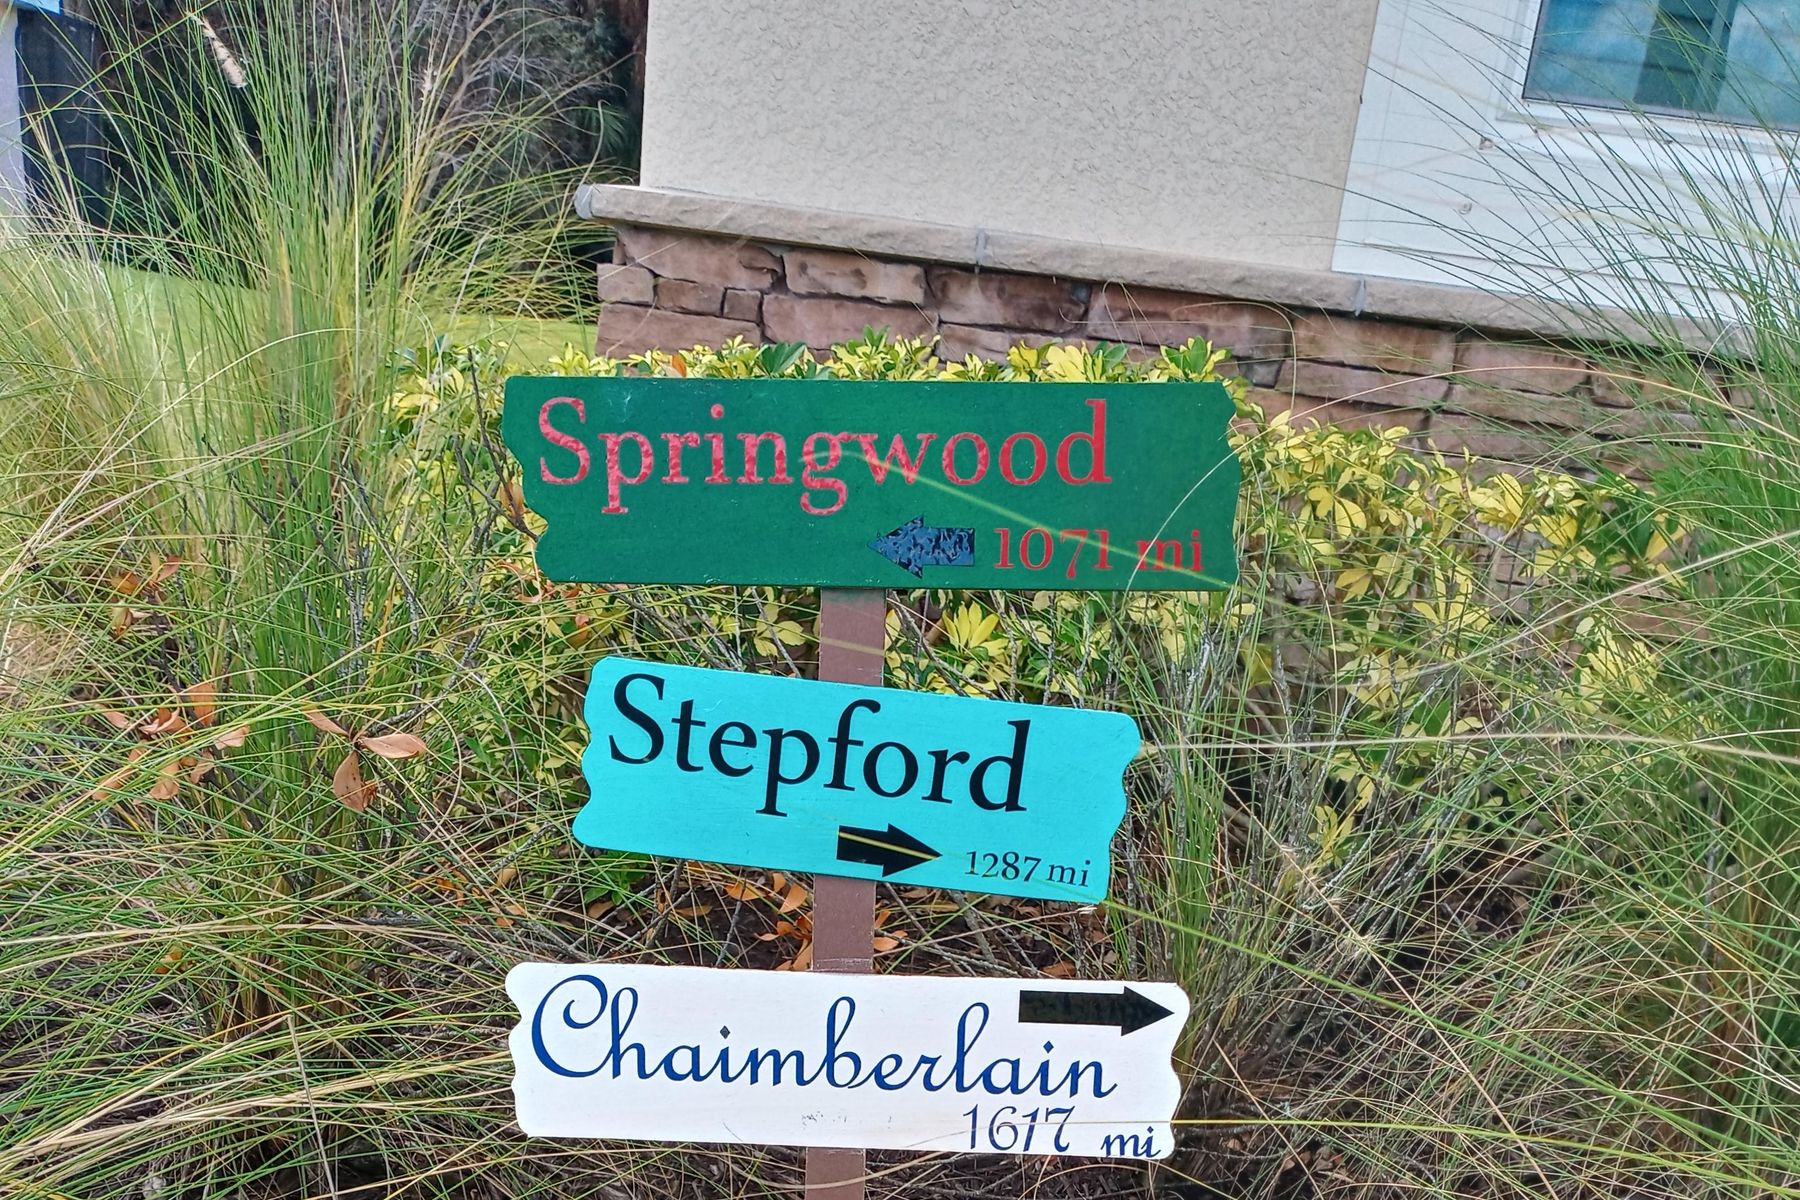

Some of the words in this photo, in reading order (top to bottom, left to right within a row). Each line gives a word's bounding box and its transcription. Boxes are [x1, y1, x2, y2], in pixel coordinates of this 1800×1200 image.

[537, 396, 1112, 517] Springwood
[993, 527, 1112, 580] 1071
[1135, 528, 1205, 573] mi
[608, 673, 1031, 818] Stepford
[963, 850, 1042, 882] 1287
[1048, 859, 1092, 887] mi
[531, 974, 1118, 1099] Chaimberlain
[962, 1103, 1073, 1155] 1617
[1101, 1126, 1162, 1159] mi
